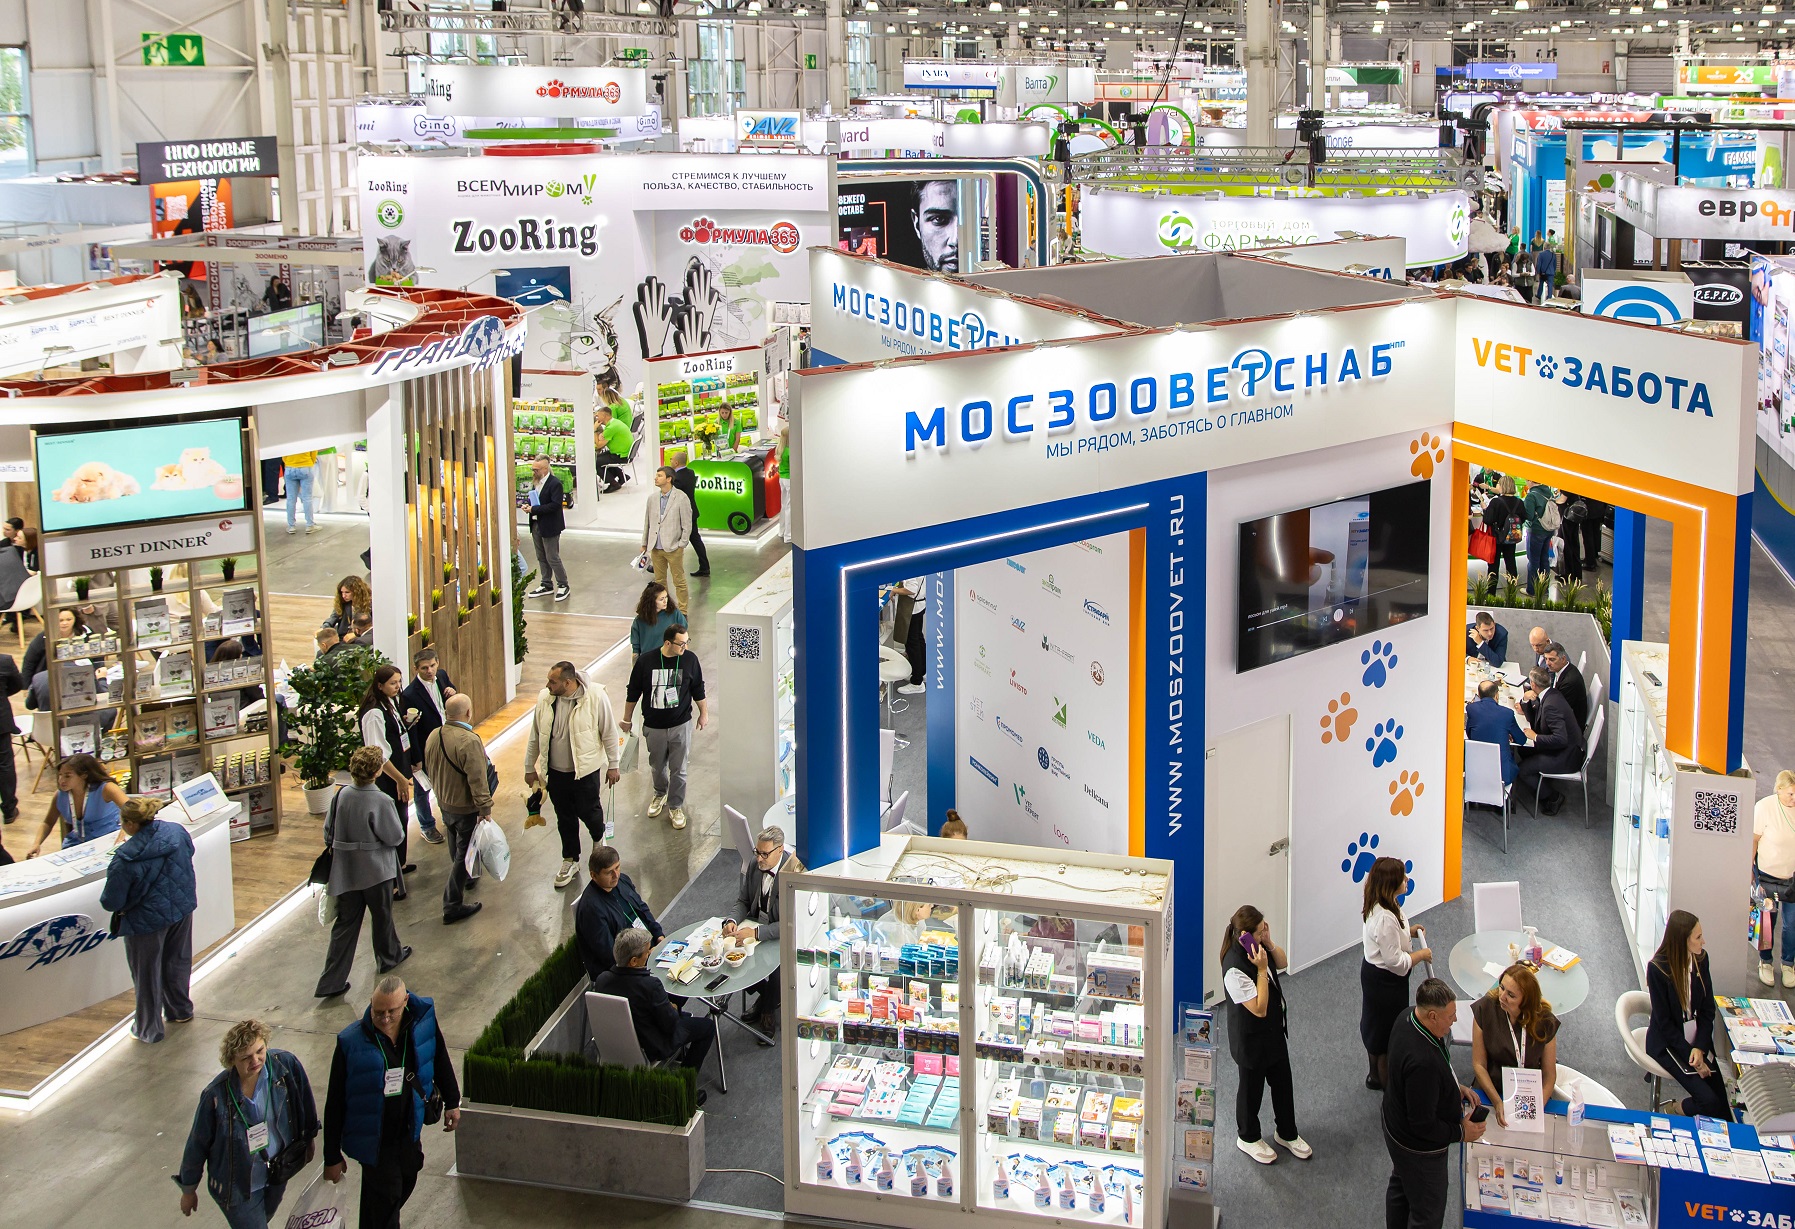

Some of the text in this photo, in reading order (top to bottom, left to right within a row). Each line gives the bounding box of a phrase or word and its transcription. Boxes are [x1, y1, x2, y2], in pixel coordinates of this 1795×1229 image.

[1025, 76, 1047, 90] Валта
[419, 120, 450, 130] Gina
[749, 116, 798, 134] AVZ
[165, 141, 256, 161] НПО НОВЫЕ
[162, 156, 260, 178] ТЕХНОЛОГИИ
[671, 172, 787, 181] СТРЕМИМСЯ К ЛУЧШЕМУ
[368, 180, 408, 195] ZooRing
[643, 182, 814, 191] ПОЛЬЗА, КАЧЕСТВО, СТАБИЛЬНОСТЬ
[679, 217, 798, 245] ФОРМУЛА 365
[1212, 218, 1311, 231] ТОРГОВЫЙ ДОМ
[453, 218, 599, 257] ZooRing
[683, 356, 734, 375] ZooRing
[1472, 337, 1714, 418] VET ЗАБОТА
[904, 344, 1394, 453] МОСЗООВЕТСНАБ
[1046, 403, 1294, 460] МЫ РЯДОМ, ЗАБОТЯСЬ О ГЛАВНОМ
[90, 534, 209, 561] BEST DINNER
[1168, 493, 1186, 838] WWW.MOSZOOVET.RU
[1087, 730, 1106, 750] VEDA
[1684, 1201, 1729, 1222] VET
